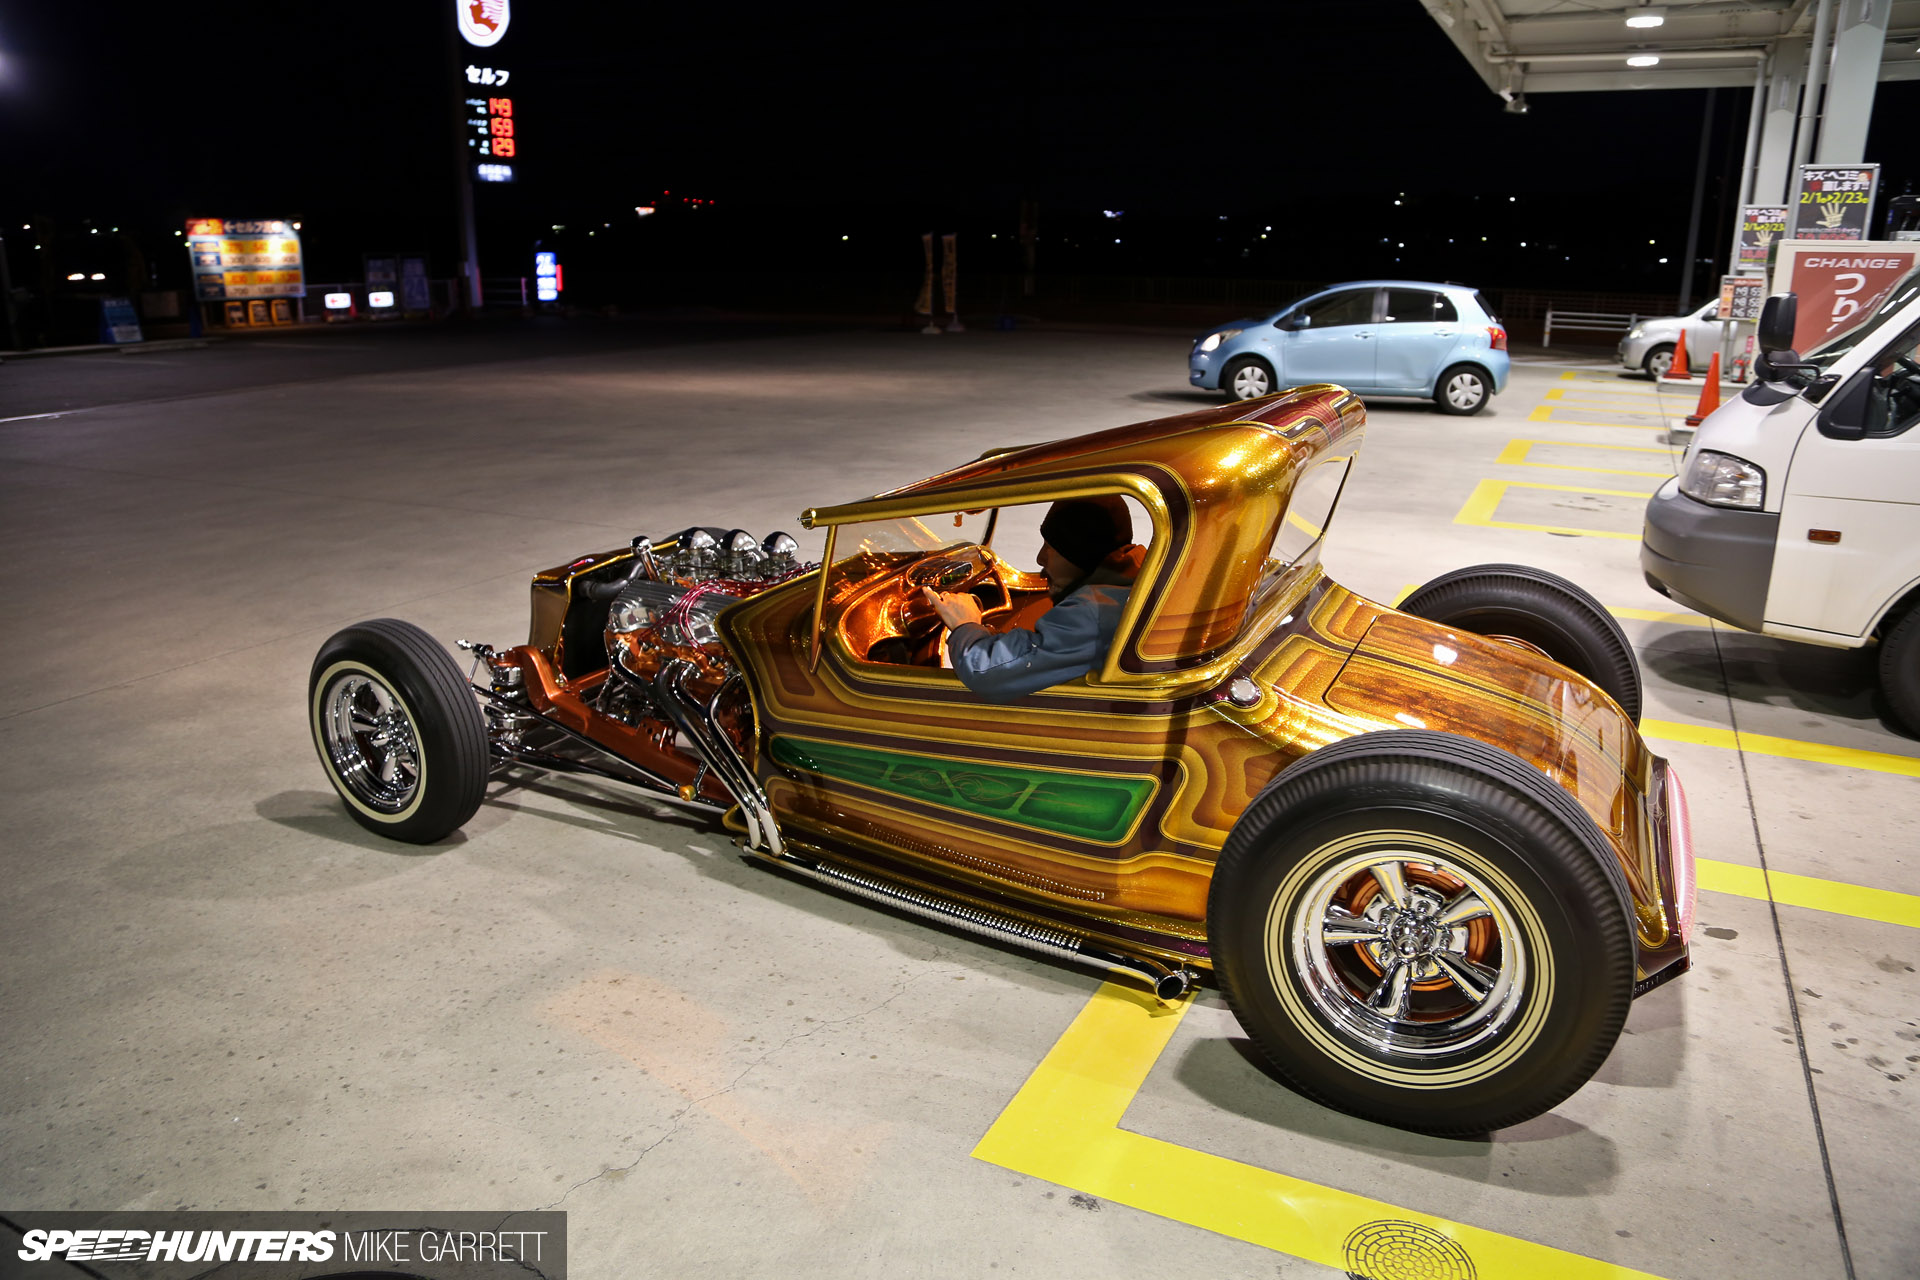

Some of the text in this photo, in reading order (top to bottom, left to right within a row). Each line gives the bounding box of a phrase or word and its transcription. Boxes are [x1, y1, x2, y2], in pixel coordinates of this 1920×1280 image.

[465, 65, 510, 86] セルフ
[1804, 257, 1902, 269] CHANGE
[1826, 272, 1866, 333] つり
